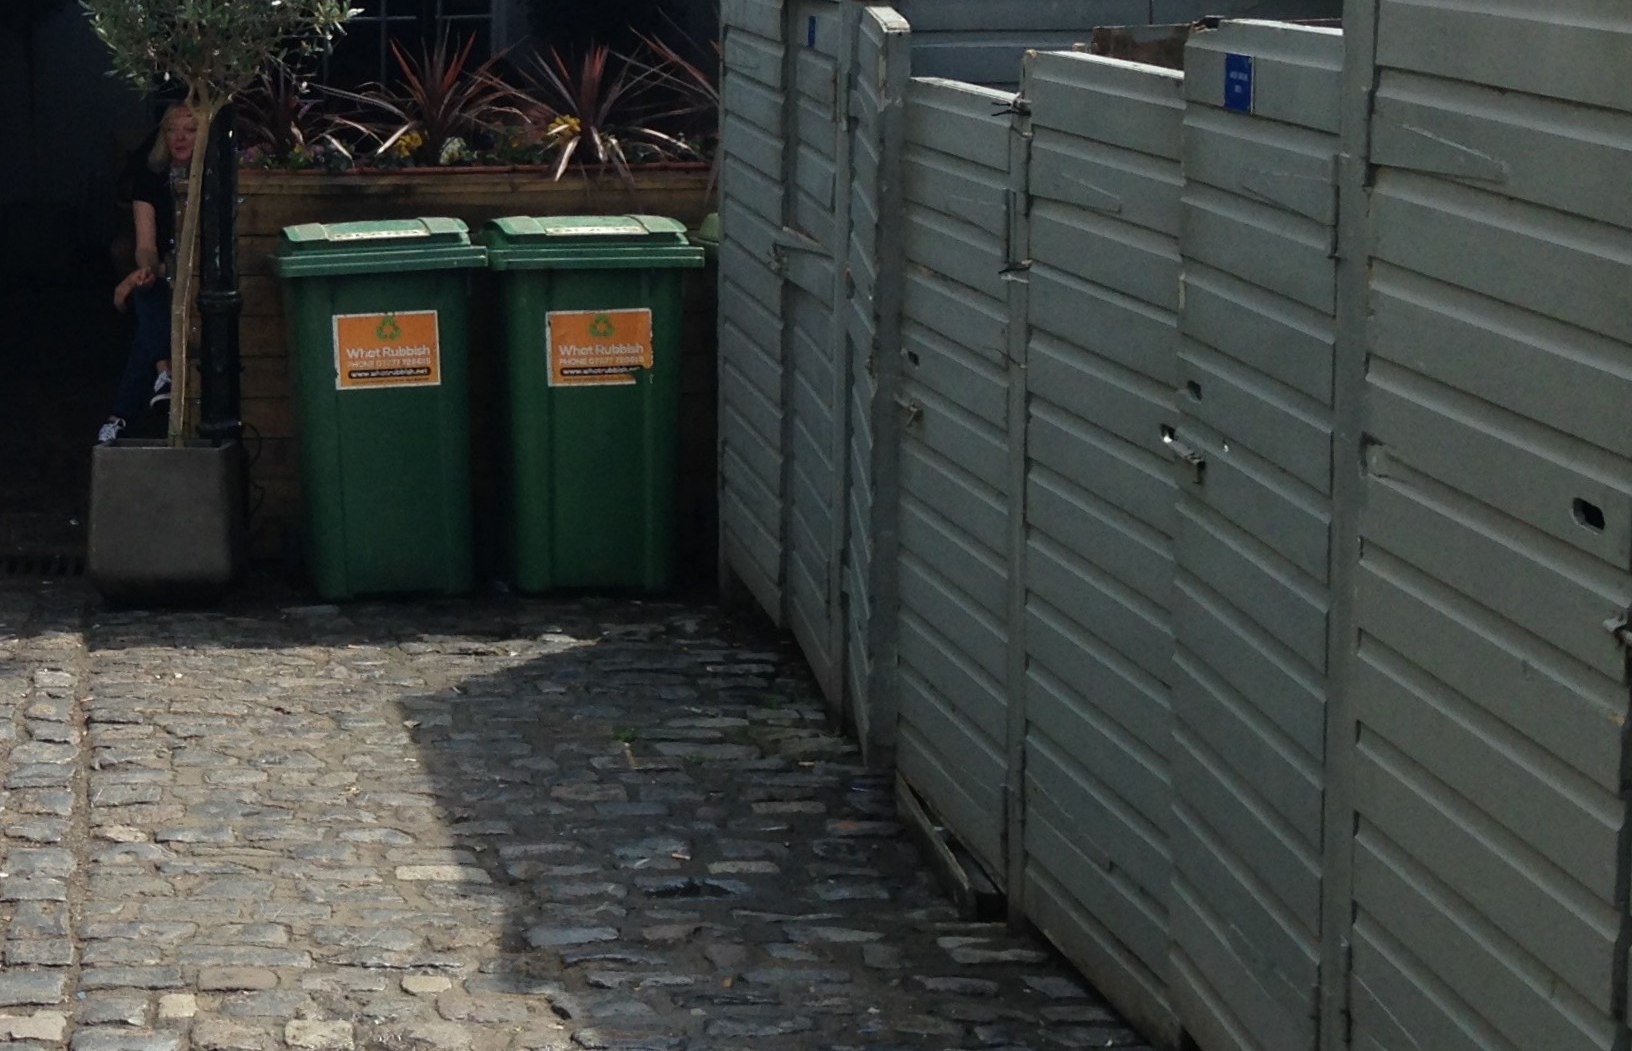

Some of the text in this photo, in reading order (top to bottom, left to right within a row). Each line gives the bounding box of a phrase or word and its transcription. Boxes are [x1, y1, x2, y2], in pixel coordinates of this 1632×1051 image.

[347, 346, 430, 358] What Rubbish
[559, 344, 643, 355] What Rubbish
